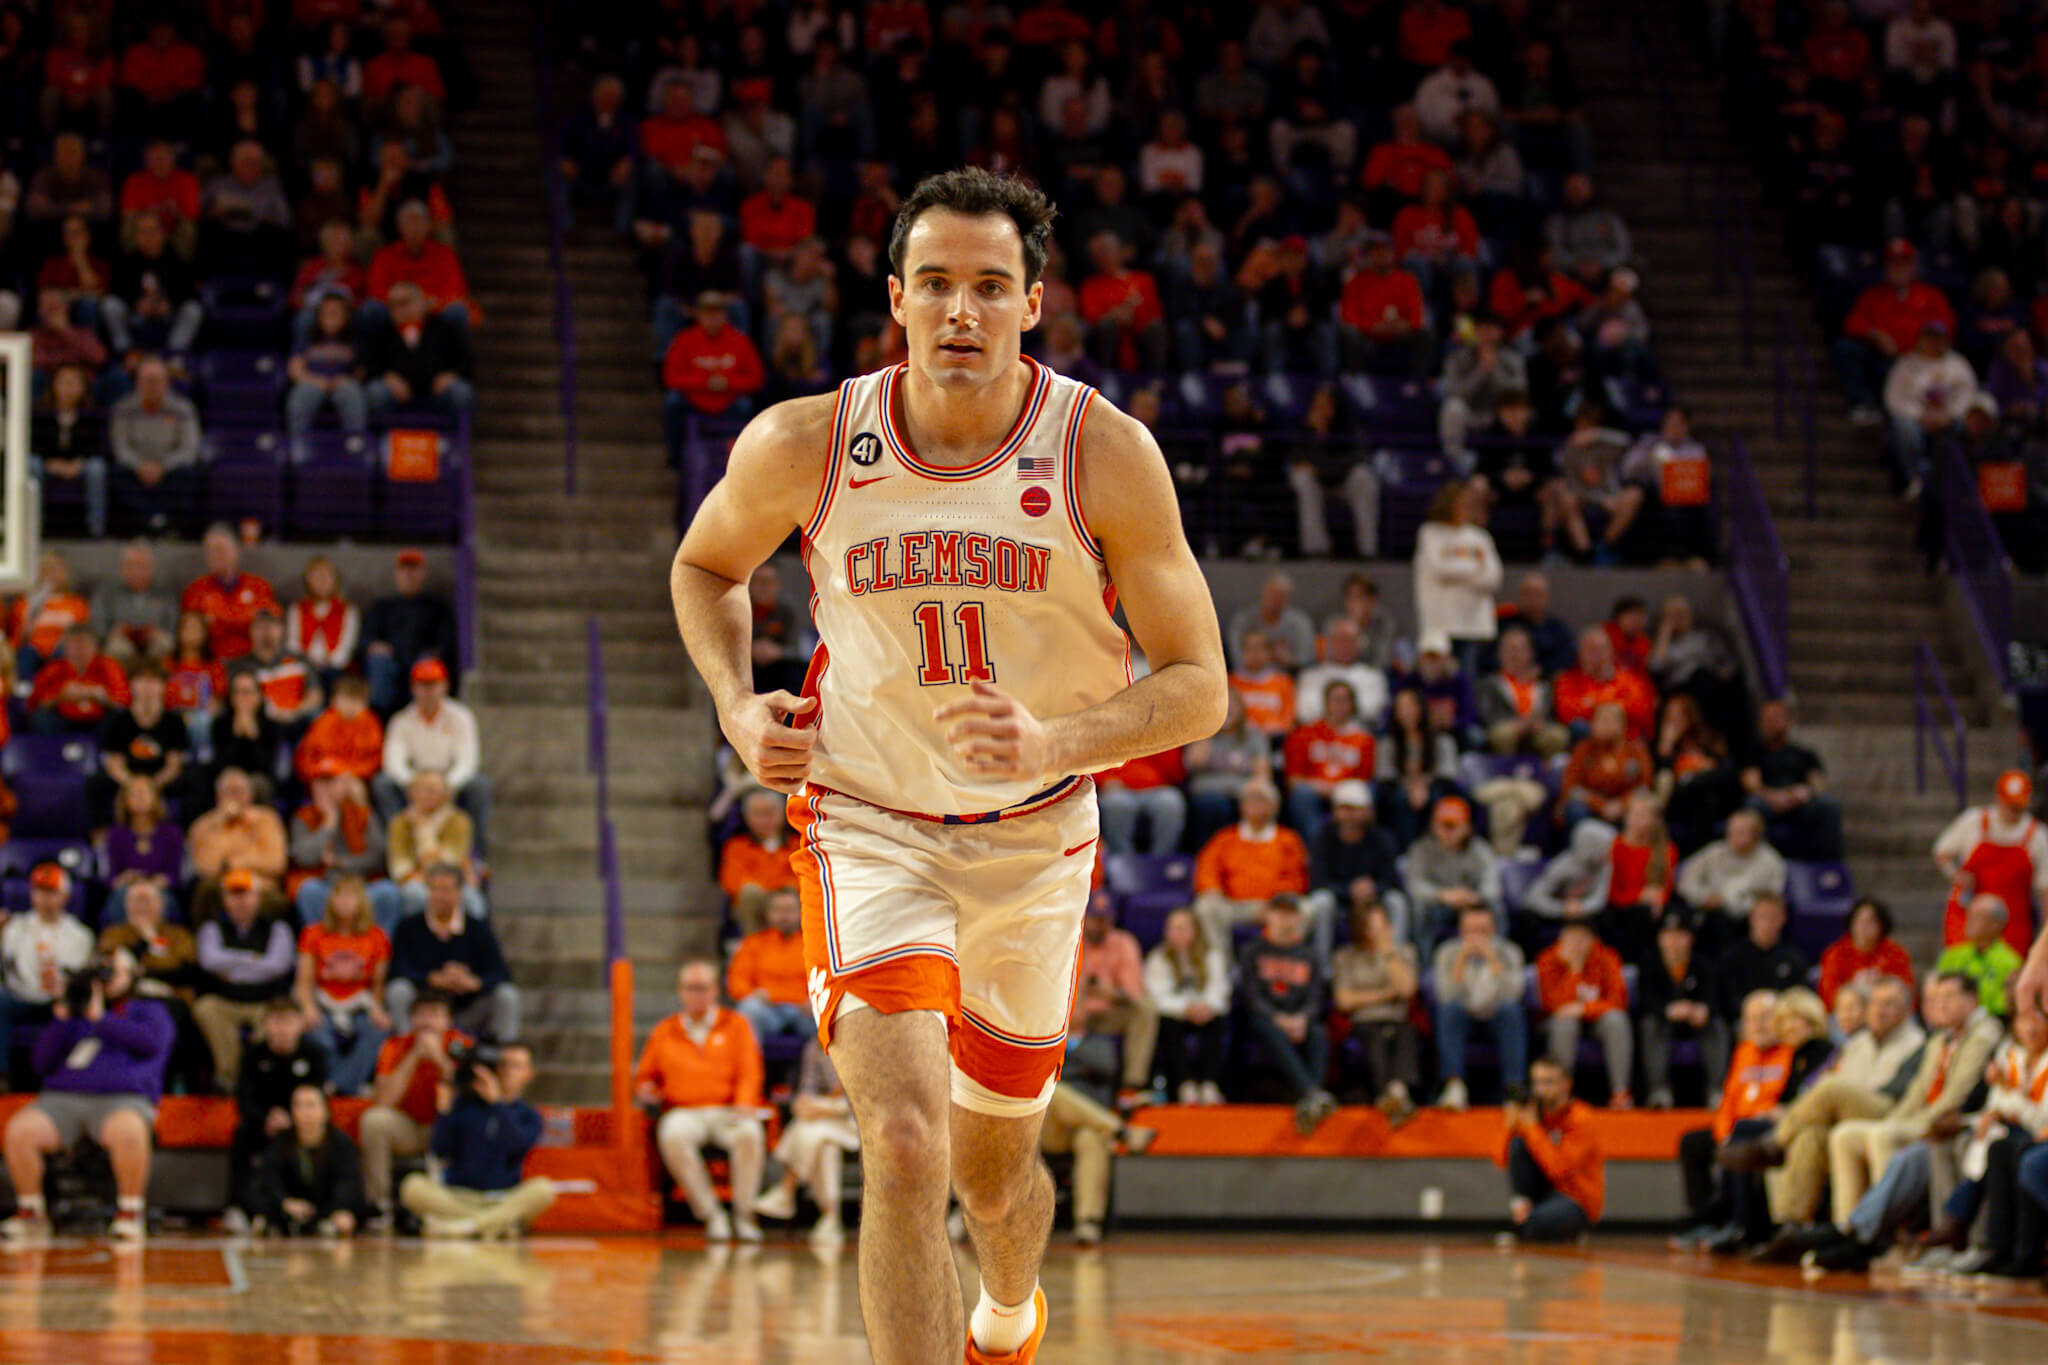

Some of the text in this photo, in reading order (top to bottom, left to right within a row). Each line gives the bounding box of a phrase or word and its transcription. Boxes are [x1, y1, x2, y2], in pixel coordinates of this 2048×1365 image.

[852, 437, 877, 462] 41
[844, 530, 1050, 597] CLEMSON
[913, 602, 997, 686] 11
